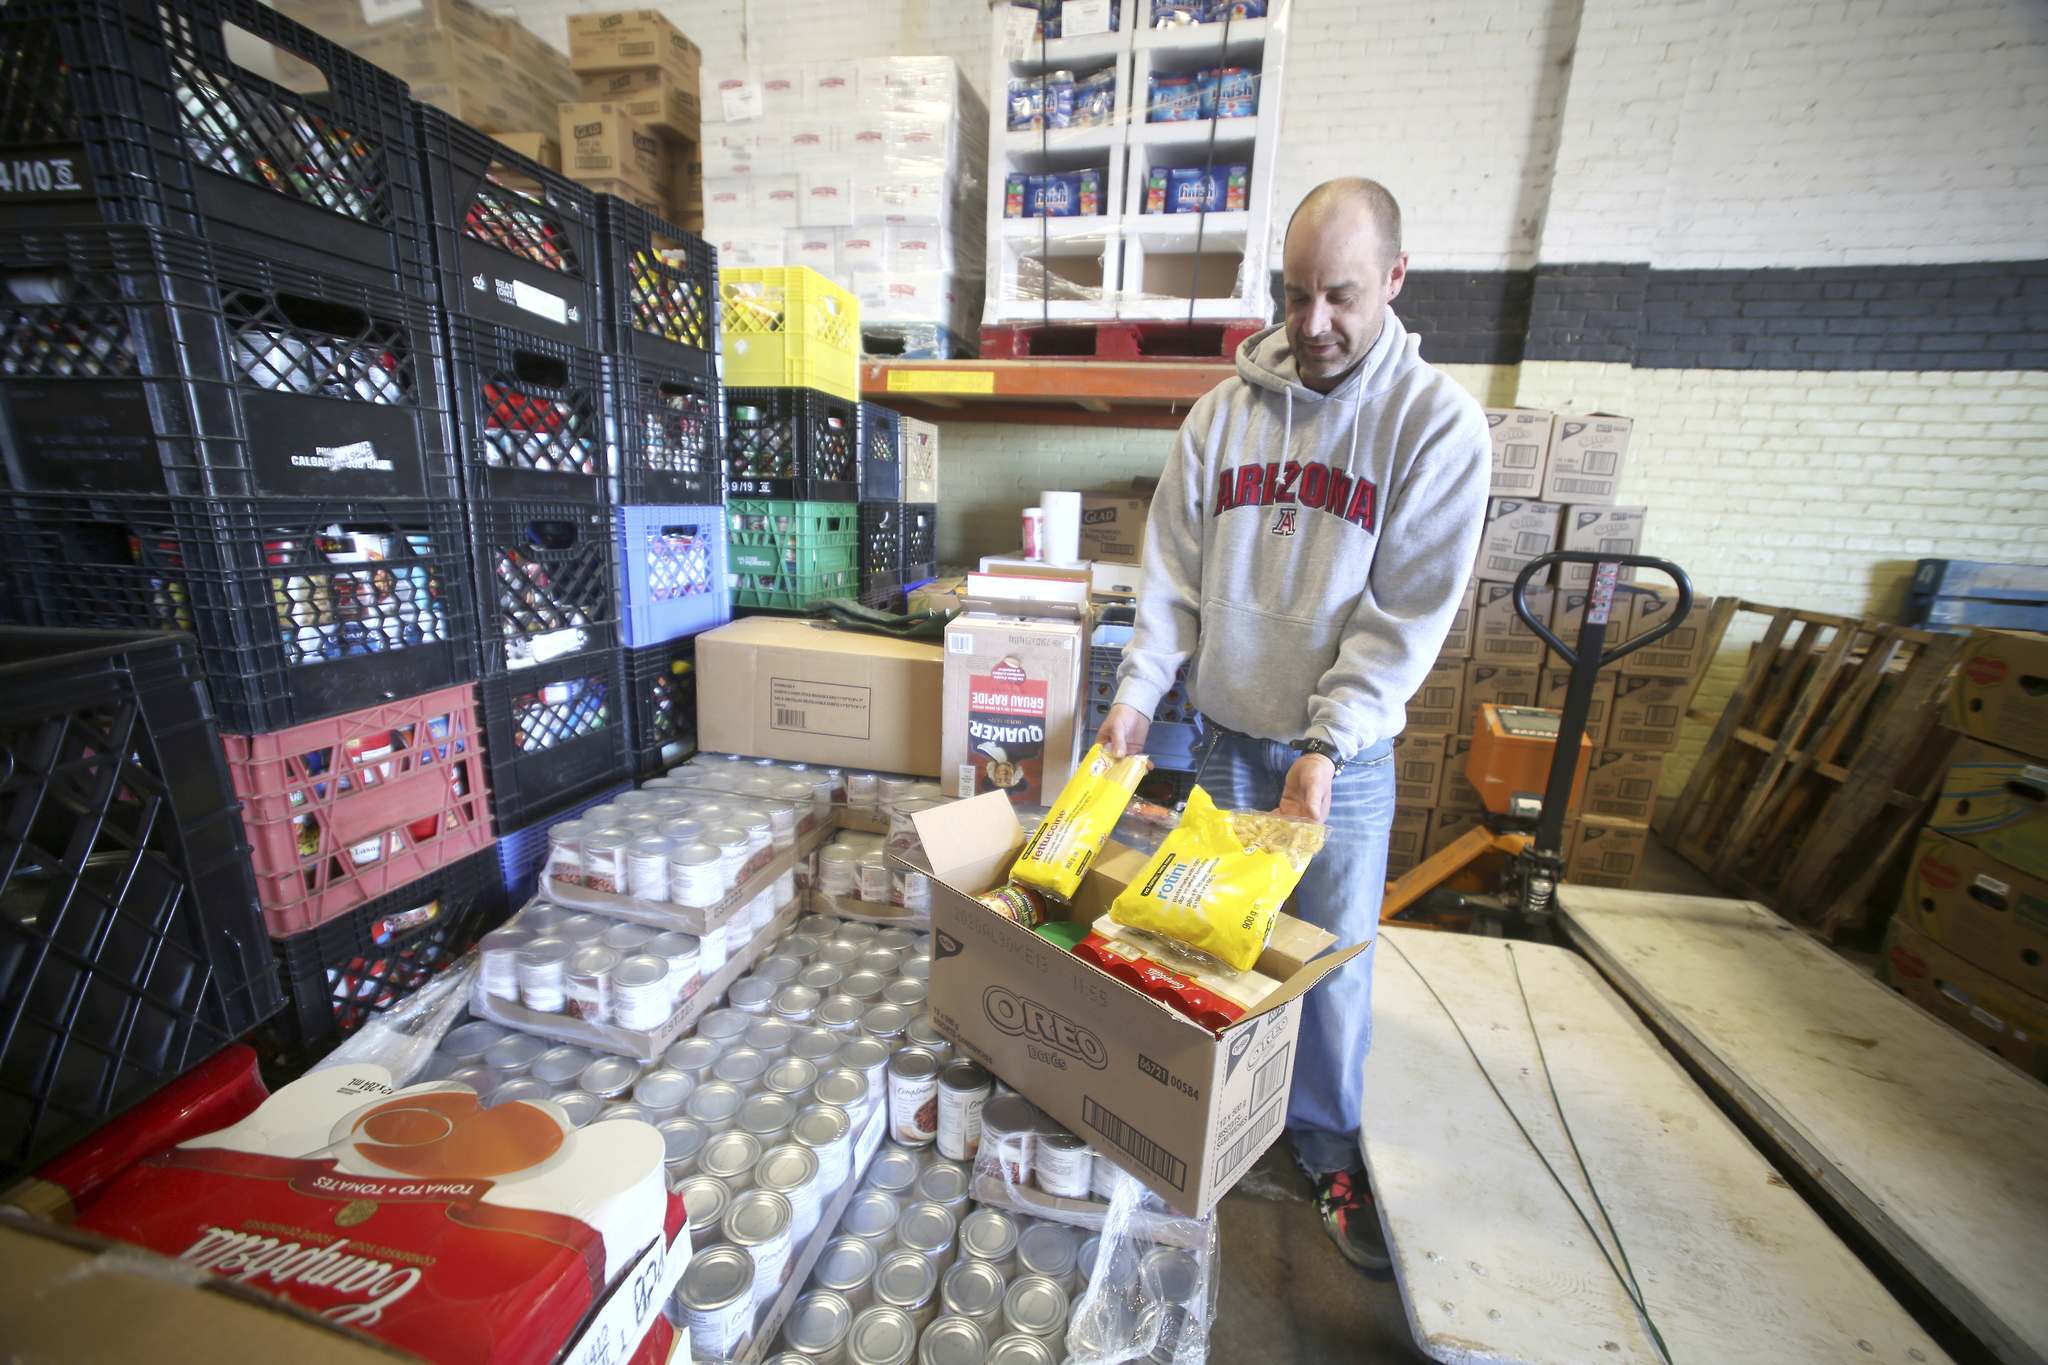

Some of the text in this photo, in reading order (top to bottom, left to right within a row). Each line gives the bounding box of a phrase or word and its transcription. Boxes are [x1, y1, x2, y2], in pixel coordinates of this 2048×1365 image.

[1213, 461, 1378, 537] ARIZONA
[1084, 510, 1114, 522] GLAD
[1272, 508, 1297, 536] A
[972, 692, 1044, 709] GRUAU RAPIDE
[970, 719, 1044, 743] QUAKER
[1033, 809, 1066, 861] fettuccine
[1157, 862, 1188, 900] rotini
[1242, 915, 1256, 930] 900
[983, 985, 1108, 1070] OREO
[1139, 1055, 1200, 1100] 66721 00584
[312, 1176, 475, 1195] TOMATO TOMATES
